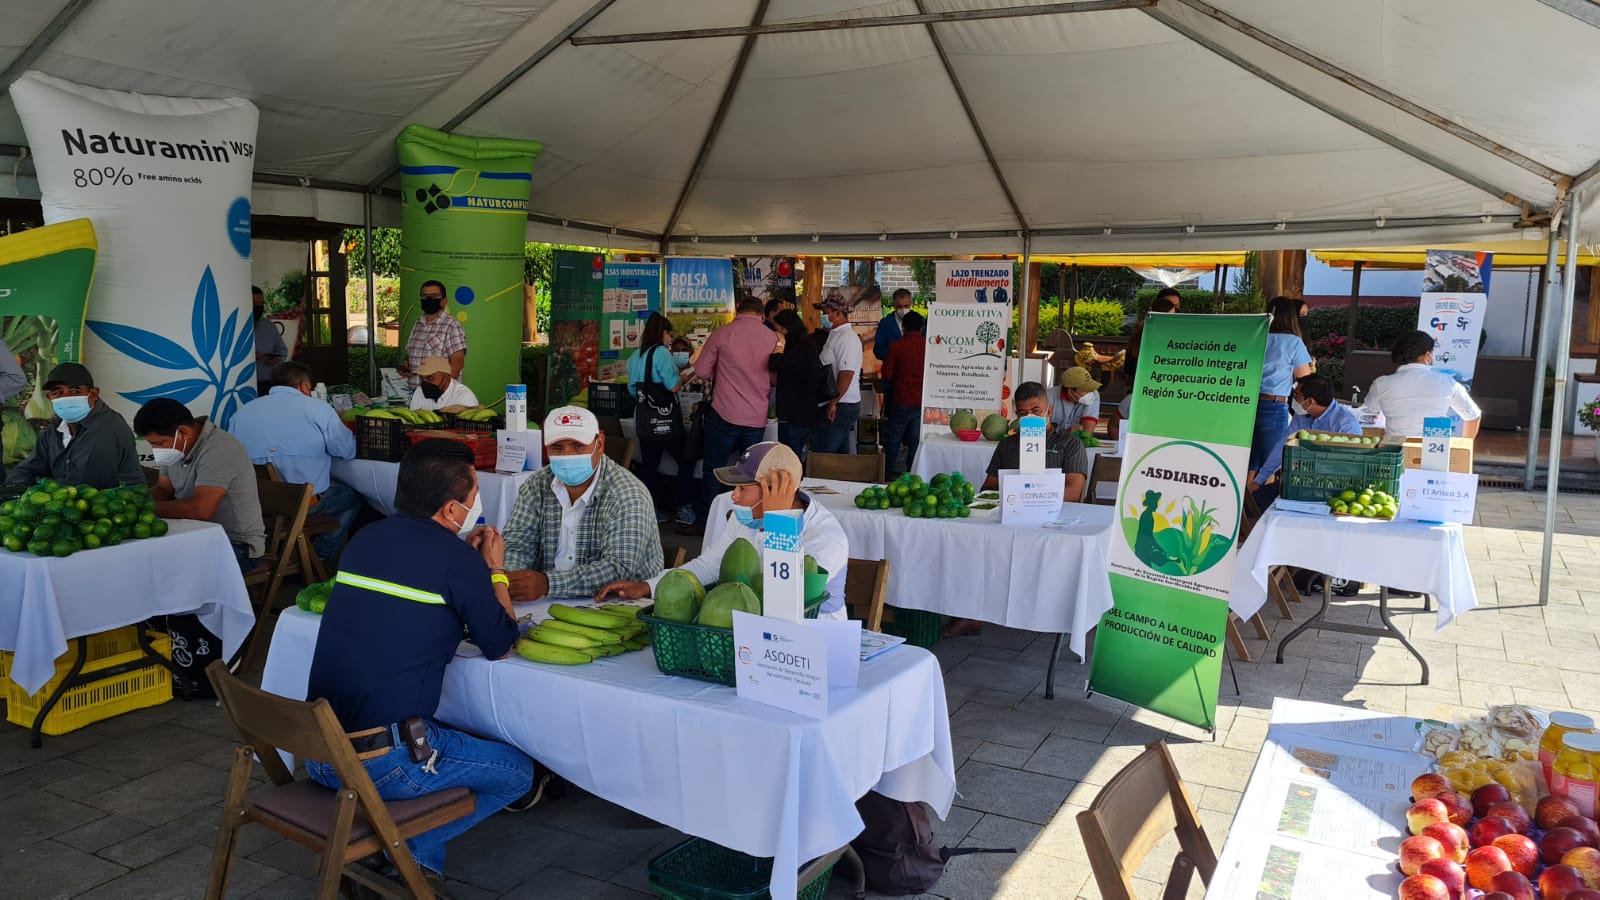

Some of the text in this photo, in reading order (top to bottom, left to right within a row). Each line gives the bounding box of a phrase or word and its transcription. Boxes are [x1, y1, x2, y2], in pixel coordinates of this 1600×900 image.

[73, 166, 202, 188] 80% Free amino acids
[671, 272, 709, 286] BOLSA
[952, 270, 1009, 278] LAZO TRENZADO
[946, 277, 1010, 288] Multifilamento
[934, 308, 1003, 318] COOPERATIVA
[1167, 340, 1236, 352] Asociación de
[1153, 355, 1248, 371] Desarrollo Integral
[1150, 371, 1246, 387] Agropecuario de la
[1142, 386, 1251, 404] Región Sur-Occidente
[508, 404, 516, 413] 20
[1026, 442, 1039, 453] 21
[1428, 442, 1445, 454] 24
[1431, 488, 1455, 497] Arisco
[770, 561, 790, 580] 18
[1108, 607, 1217, 644] DEL CAMPO A LA CIUDAD
[1104, 618, 1217, 658] PRODUCCIÓN DE CALIDAD
[764, 648, 810, 670] ASODETI
